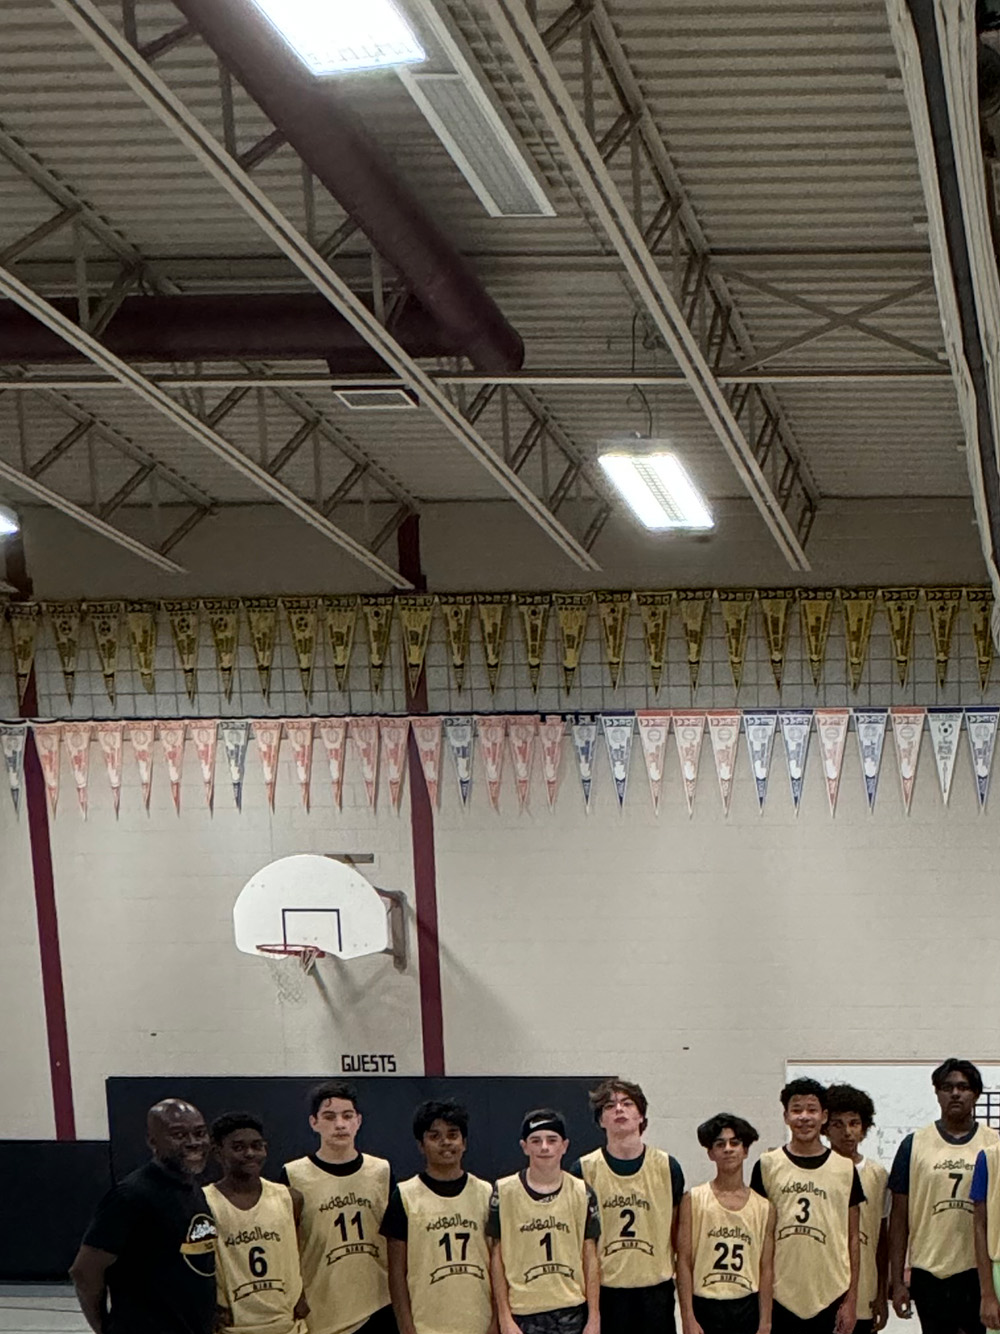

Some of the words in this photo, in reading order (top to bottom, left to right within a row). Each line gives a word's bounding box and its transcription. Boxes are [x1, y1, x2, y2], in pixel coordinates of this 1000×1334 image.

[341, 1054, 397, 1073] GUESTS
[948, 1172, 963, 1198] 7
[620, 1208, 636, 1237] 2
[795, 1197, 811, 1224] 3
[334, 1211, 364, 1241] 11
[439, 1232, 470, 1261] 17
[540, 1232, 552, 1261] 1
[713, 1242, 744, 1272] 25
[249, 1246, 268, 1278] 6
